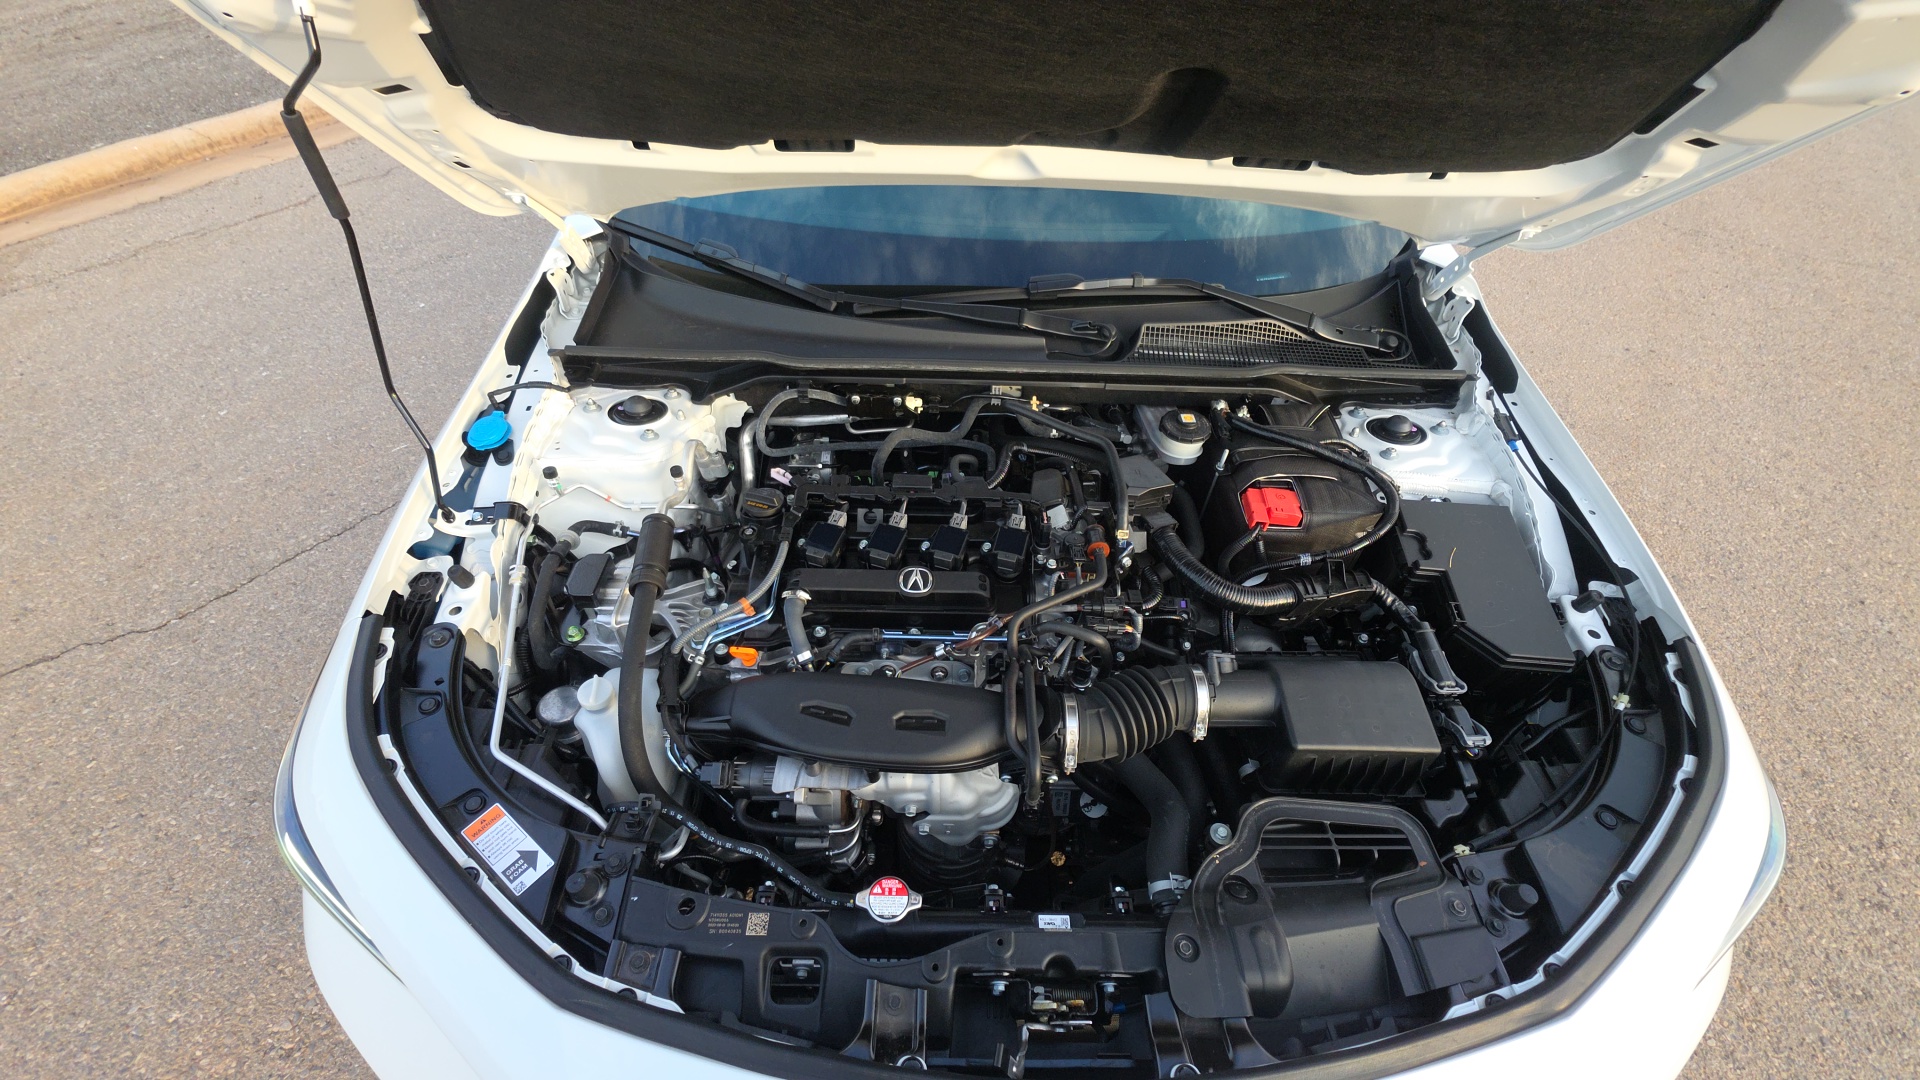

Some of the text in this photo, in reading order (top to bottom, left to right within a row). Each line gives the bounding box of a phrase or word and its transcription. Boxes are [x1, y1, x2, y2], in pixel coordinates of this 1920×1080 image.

[472, 815, 500, 837] WARNING
[506, 860, 524, 875] GRAB
[510, 864, 528, 880] FOAM
